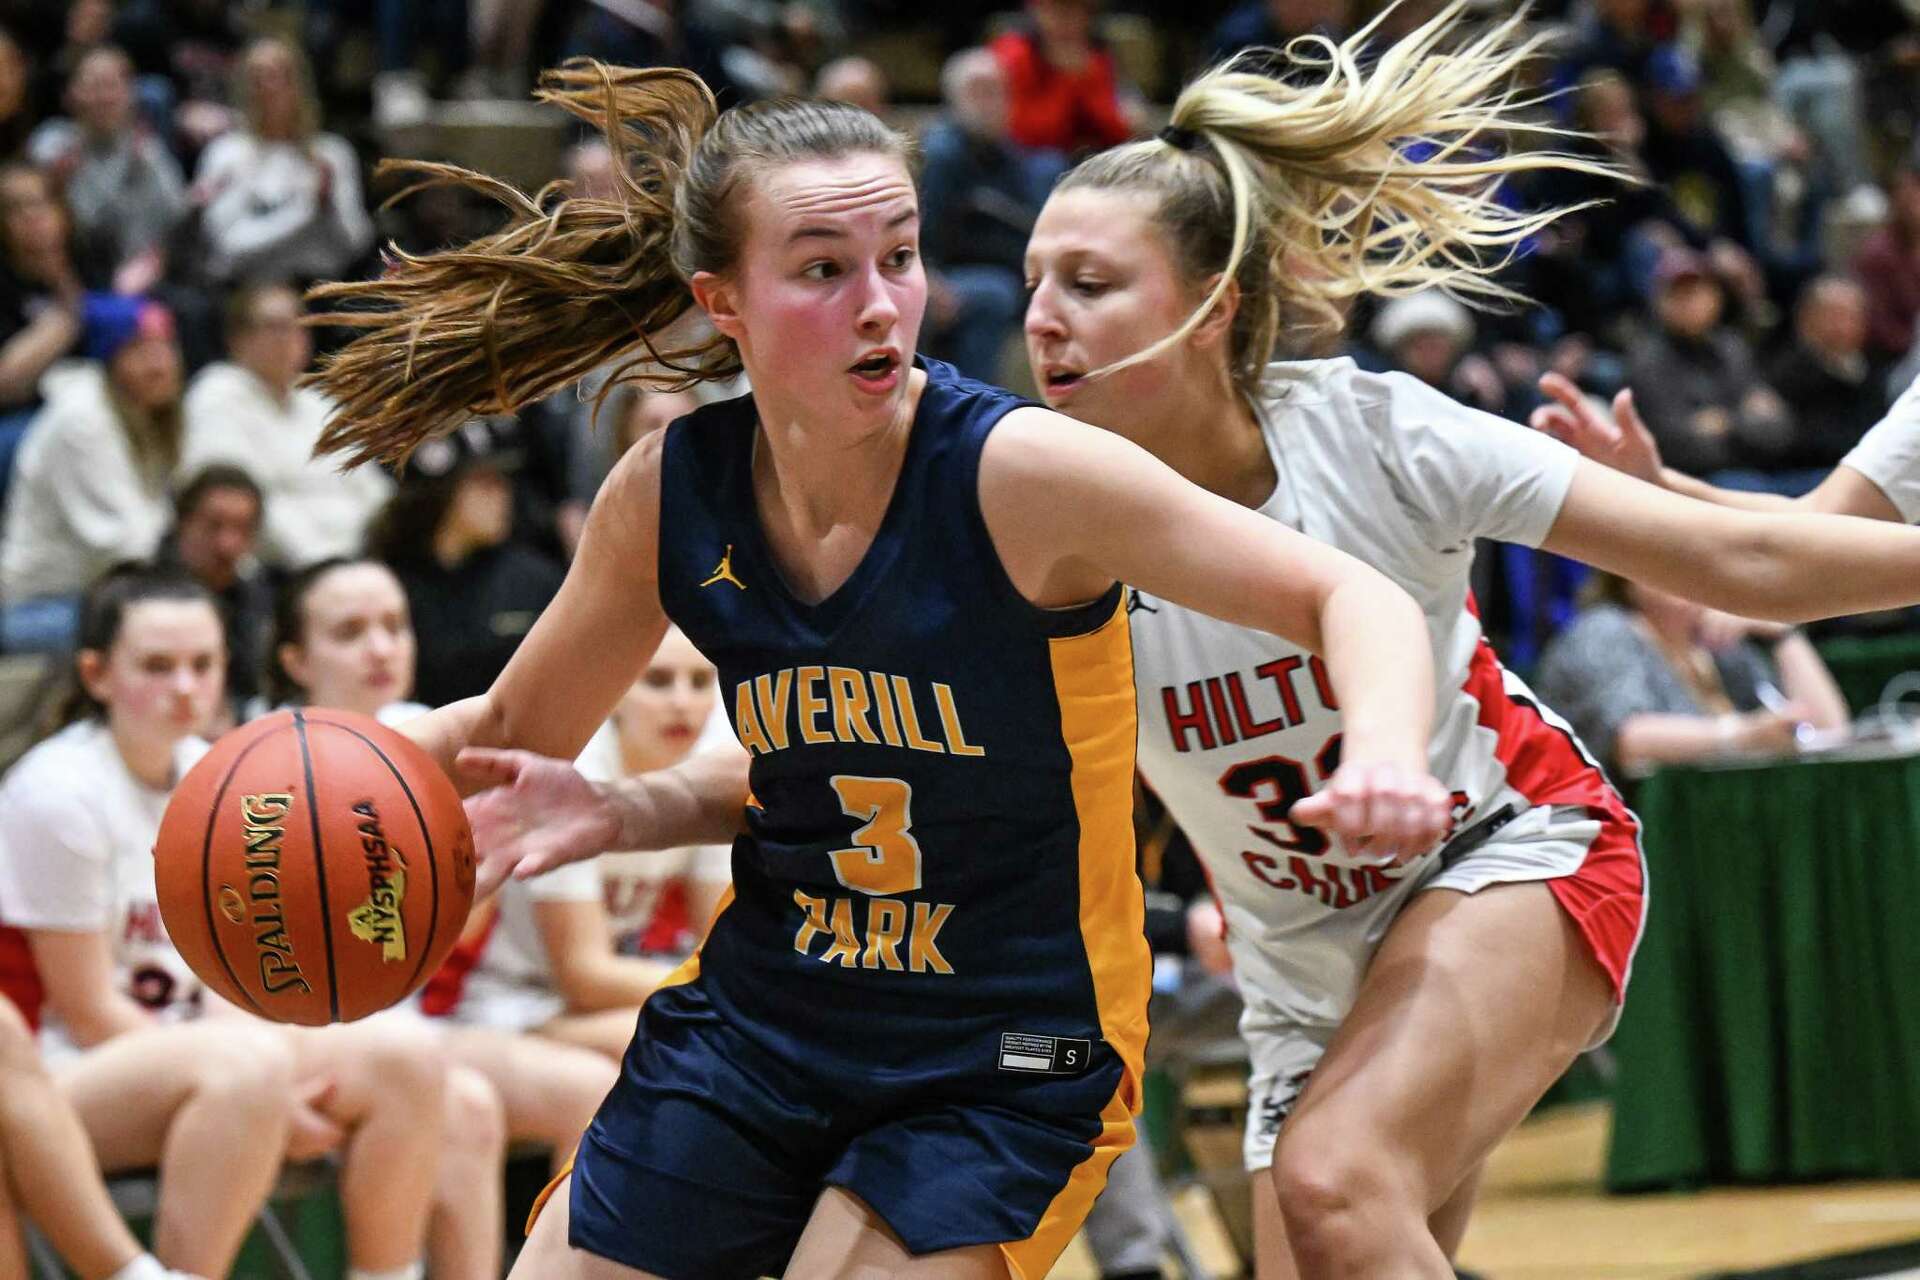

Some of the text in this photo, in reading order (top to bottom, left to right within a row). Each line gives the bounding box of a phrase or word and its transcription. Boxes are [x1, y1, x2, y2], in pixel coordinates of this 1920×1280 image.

[736, 666, 985, 756] AVERILL
[1161, 654, 1340, 752] HILT
[827, 775, 922, 896] 3
[1218, 732, 1343, 856] 3
[241, 793, 312, 993] SPALDING
[353, 800, 396, 943] NYSPHSAA
[793, 888, 955, 974] PARK
[1065, 1049, 1077, 1065] S
